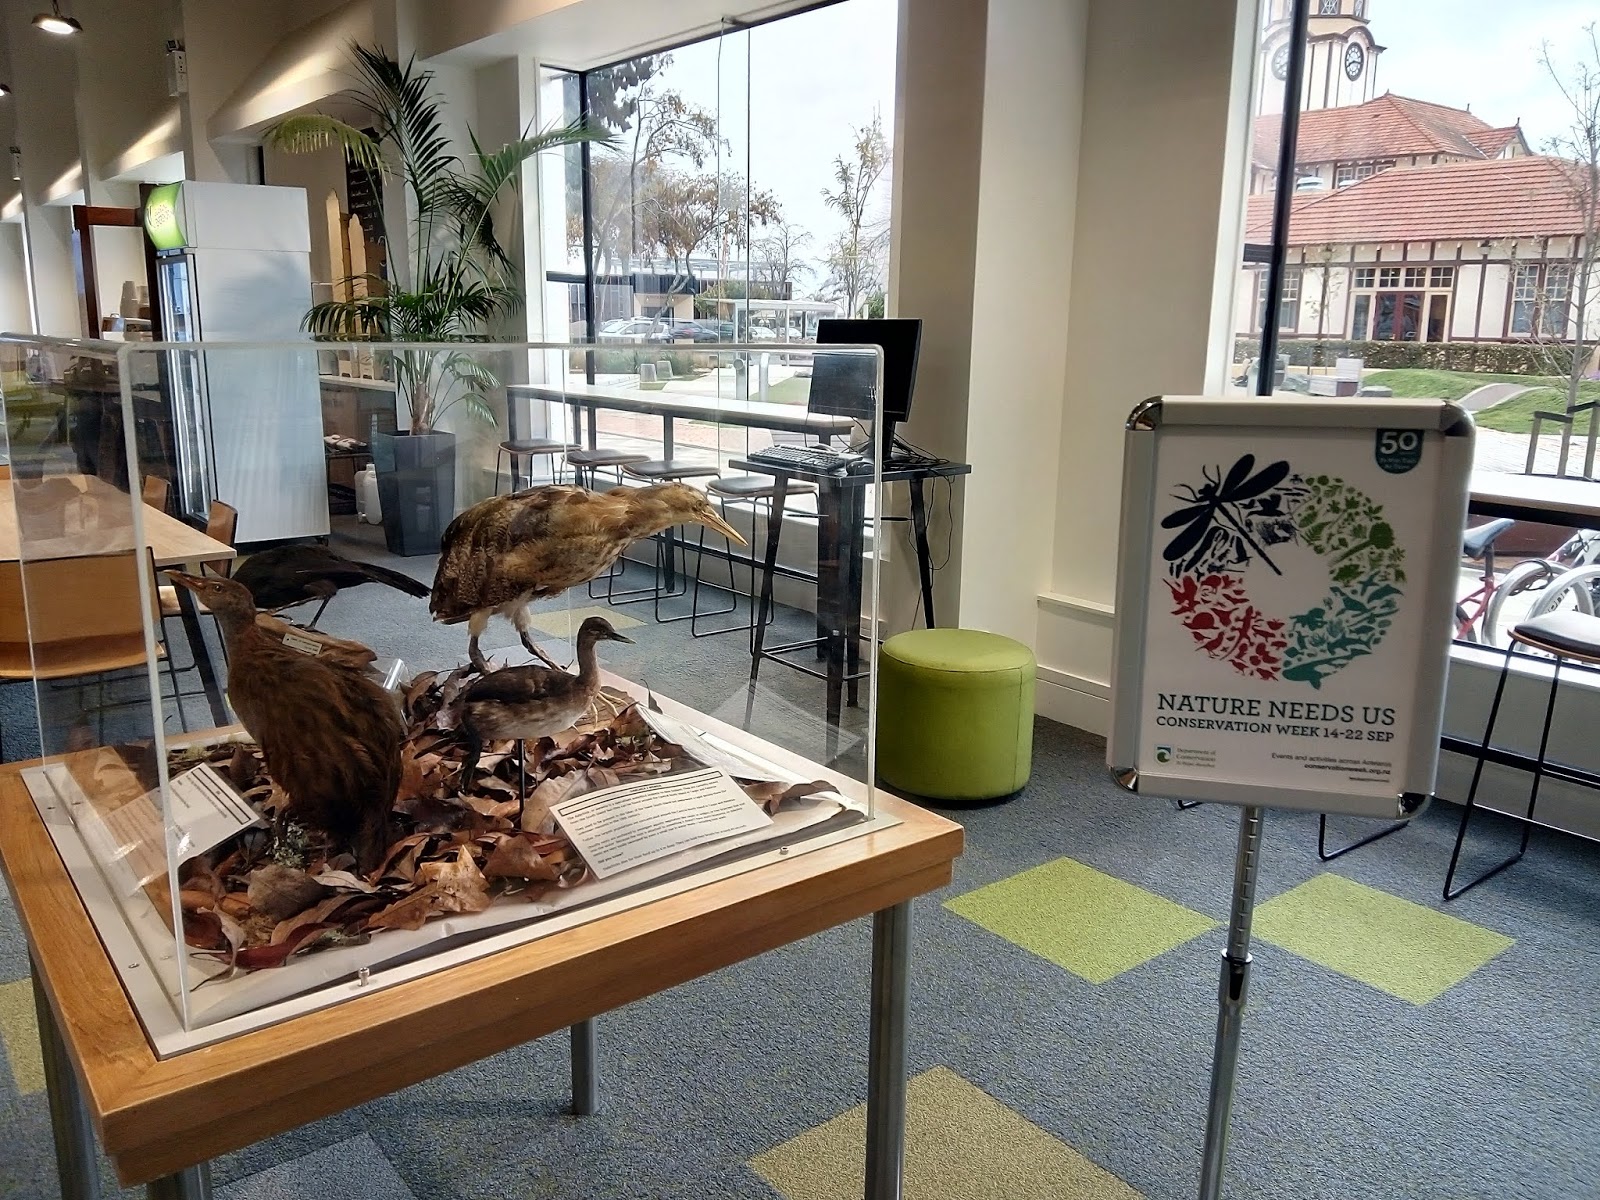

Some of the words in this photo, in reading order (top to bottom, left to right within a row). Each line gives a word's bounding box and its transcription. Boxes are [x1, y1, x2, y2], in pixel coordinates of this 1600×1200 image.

[1381, 431, 1418, 454] 50
[1157, 693, 1262, 717] NATURE
[1268, 701, 1355, 723] NEEDS
[1363, 706, 1396, 726] US
[1156, 716, 1272, 734] CONSERVATION
[1275, 724, 1321, 738] WEEK
[1324, 728, 1364, 741] 14-22
[1368, 730, 1395, 743] SEP
[1271, 752, 1294, 760] Events
[1304, 763, 1391, 775] conservationweek.org.nz
